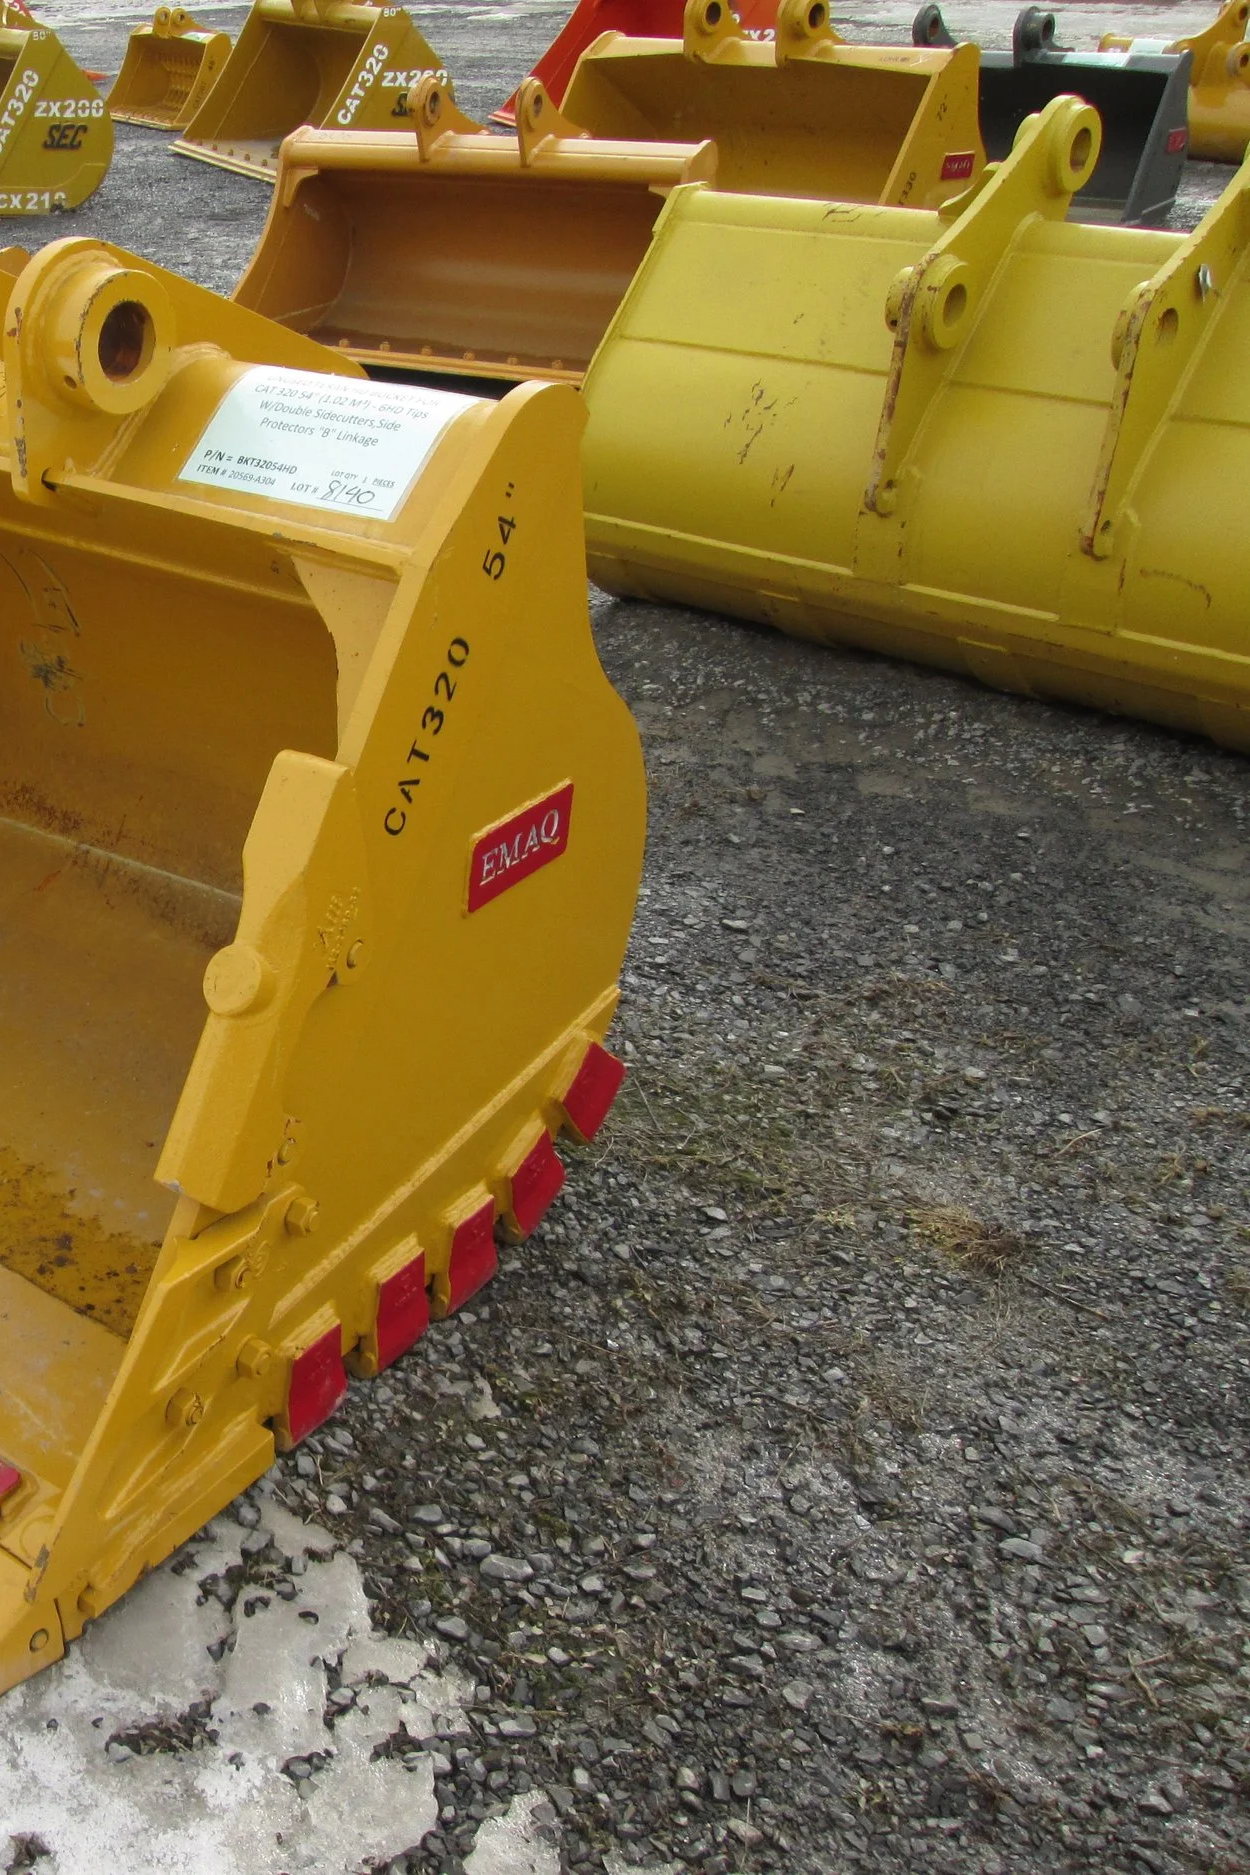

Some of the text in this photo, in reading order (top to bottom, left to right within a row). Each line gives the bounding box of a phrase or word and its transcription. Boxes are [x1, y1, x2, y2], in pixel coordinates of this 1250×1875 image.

[337, 44, 390, 125] CAT320
[34, 99, 104, 117] ZX200
[42, 124, 88, 150] SEC
[255, 384, 278, 394] CAT
[276, 387, 298, 398] 320
[319, 394, 349, 407] (1.02
[378, 403, 405, 415] 6HD
[406, 406, 430, 420] Tips
[260, 399, 313, 418] W/Double
[260, 416, 316, 436] Protectors
[336, 430, 379, 448] Linkage
[197, 464, 220, 476] ITEM
[228, 470, 277, 486] 20569-A304
[204, 449, 226, 461] P/N
[237, 455, 298, 475] BKT32054HD
[290, 482, 312, 494] LOT
[320, 479, 376, 505] 8140
[331, 469, 345, 478] LOT
[372, 477, 397, 489] PIECES
[382, 636, 471, 837] CAT320
[480, 807, 562, 887] EMAQ
